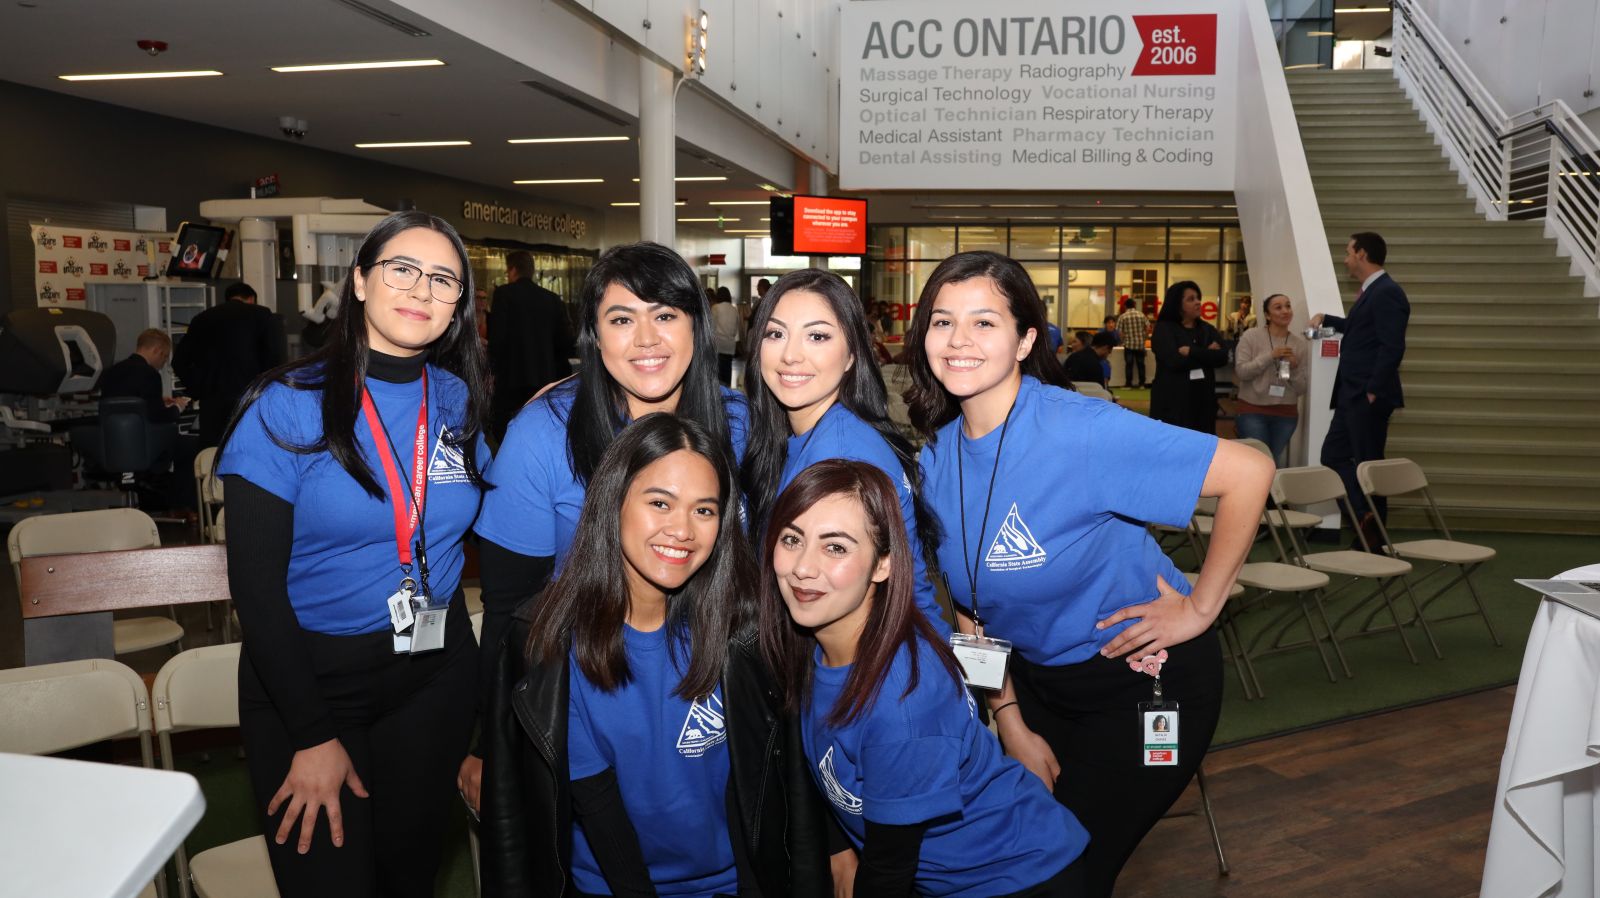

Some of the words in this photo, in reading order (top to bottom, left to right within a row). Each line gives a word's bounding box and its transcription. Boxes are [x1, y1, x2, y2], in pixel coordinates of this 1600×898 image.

[861, 19, 943, 60] ACC
[953, 14, 1126, 58] ONTARIO
[1151, 26, 1186, 44] est.
[1150, 46, 1197, 65] 2006
[859, 67, 938, 83] Massage
[942, 65, 1012, 82] Therapy
[1019, 63, 1127, 81] Radiography
[859, 88, 928, 104] Surgical
[933, 86, 1032, 103] Technology
[1041, 84, 1137, 100] Vocational
[1143, 84, 1216, 101] Nursing
[859, 108, 927, 125] Optical
[934, 108, 1037, 123] Technician
[1042, 106, 1140, 124] Respiratory
[1143, 105, 1214, 123] Therapy
[859, 129, 922, 144] Medical
[927, 128, 1003, 143] Assistant
[1012, 128, 1106, 145] Pharmacy
[1113, 127, 1214, 142] Technician
[859, 150, 916, 165] Dental
[920, 150, 1002, 167] Assisting
[1012, 149, 1077, 164] Medical
[1082, 149, 1132, 166] Billing
[1136, 149, 1148, 164] &
[1152, 148, 1214, 166] Coding
[463, 200, 519, 226] american
[521, 210, 554, 231] career
[555, 214, 586, 240] college
[416, 424, 426, 456] college
[415, 456, 424, 484] career
